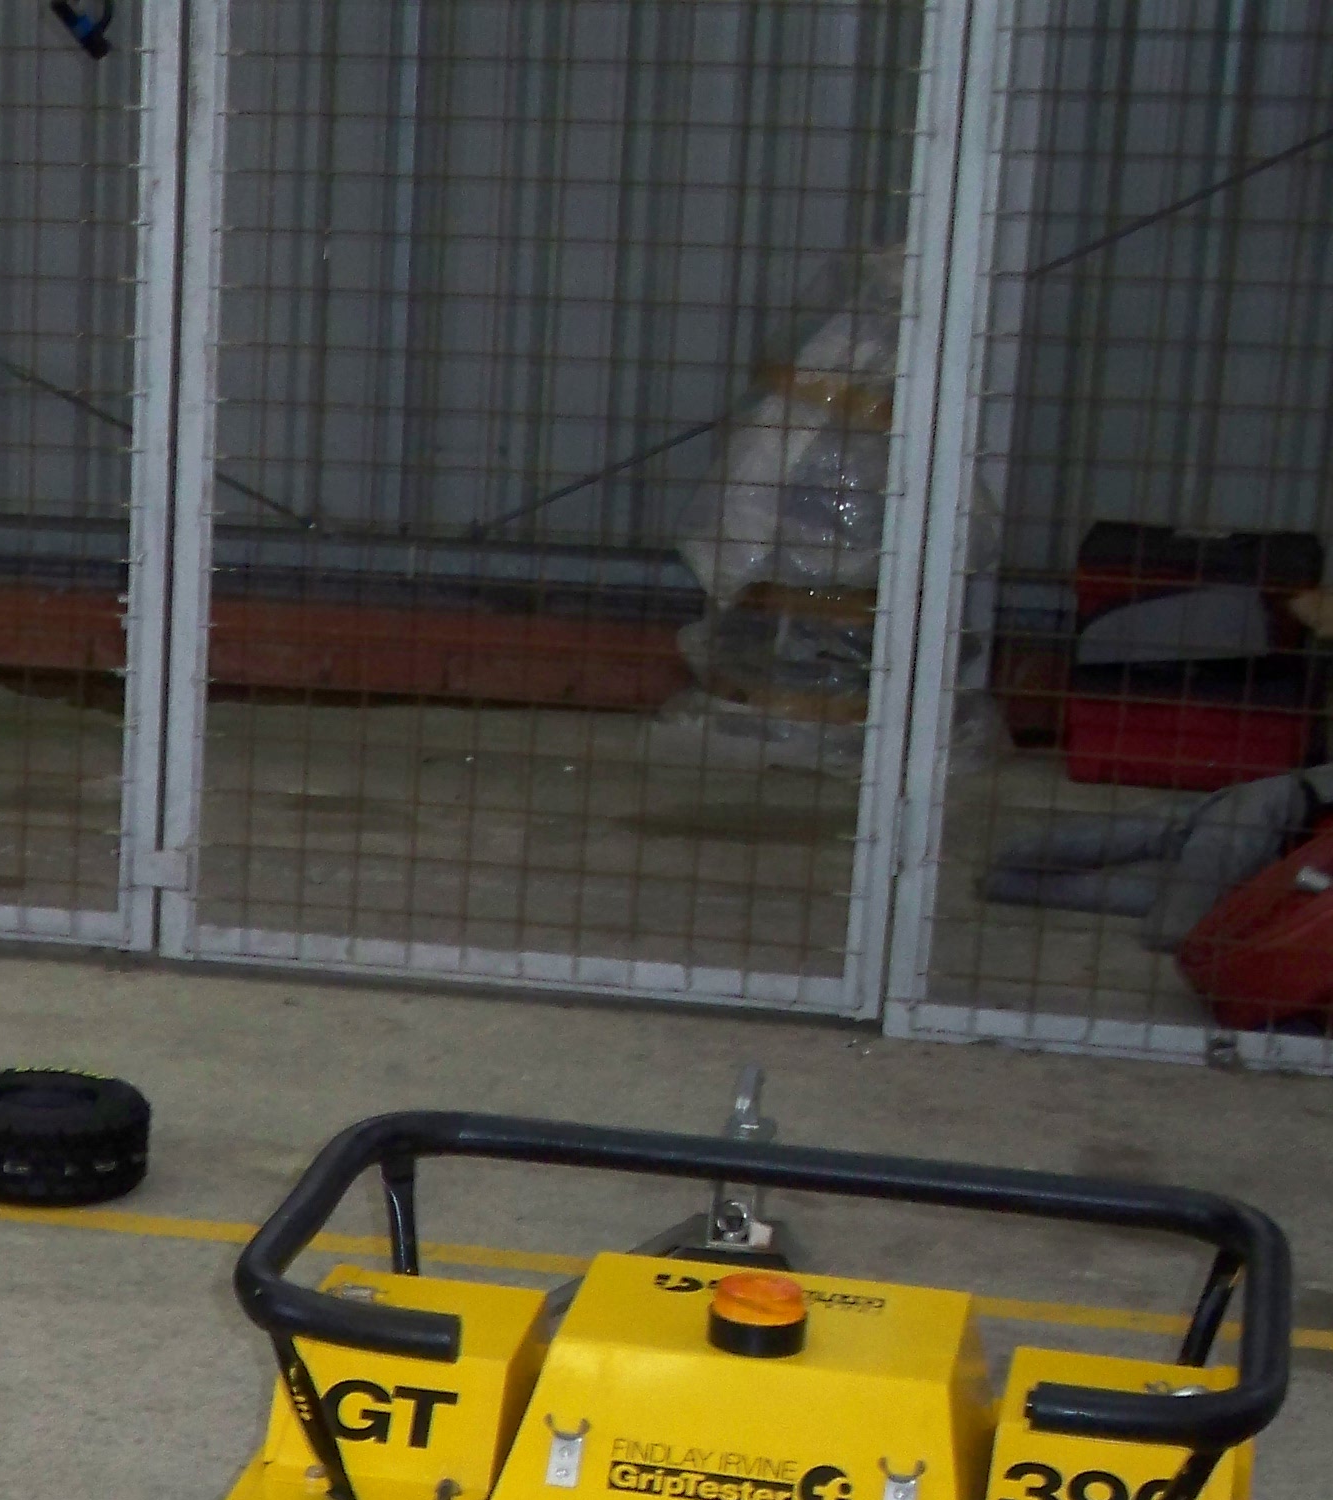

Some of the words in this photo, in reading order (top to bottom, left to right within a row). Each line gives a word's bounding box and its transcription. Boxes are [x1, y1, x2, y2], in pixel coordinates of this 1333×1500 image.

[321, 1380, 458, 1448] GT
[613, 1438, 713, 1468] FINDLAY
[717, 1452, 798, 1482] IRVINE
